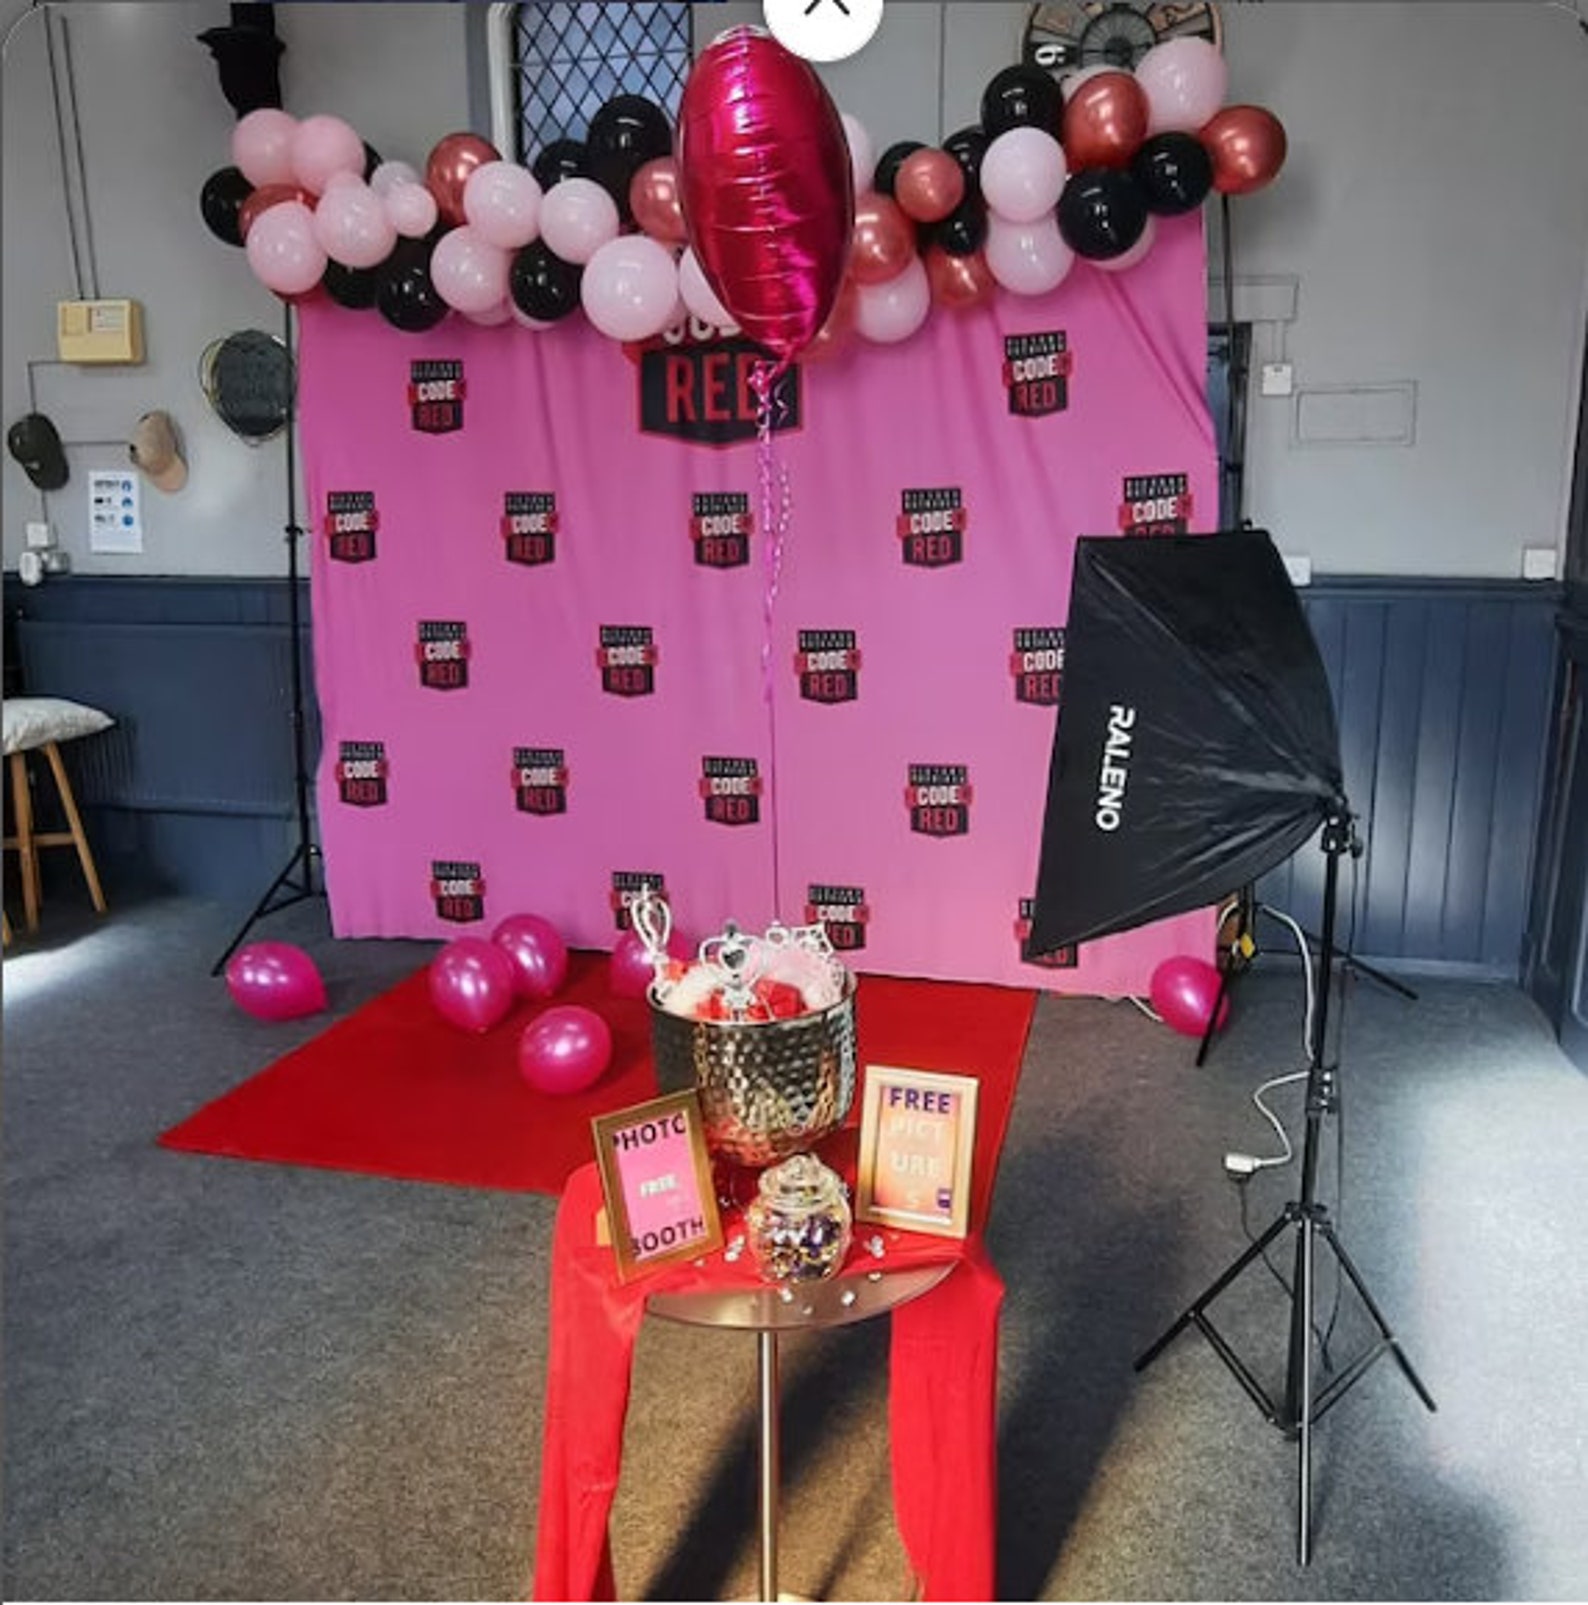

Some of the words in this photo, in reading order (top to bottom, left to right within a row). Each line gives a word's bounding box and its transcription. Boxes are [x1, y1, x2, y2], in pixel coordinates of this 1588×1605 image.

[1013, 353, 1058, 382] CODE
[1016, 381, 1056, 411] RED
[1132, 496, 1178, 523] CODE
[702, 513, 741, 537] CODE
[910, 510, 953, 534] CODE
[913, 535, 951, 561] RED
[607, 646, 645, 666] CODE
[807, 650, 847, 672] CODE
[810, 674, 847, 698] RED
[1095, 704, 1135, 831] RALENO
[711, 777, 751, 796] CODE
[917, 786, 959, 806] CODE
[919, 807, 959, 831] RED
[889, 1087, 951, 1114] FREE
